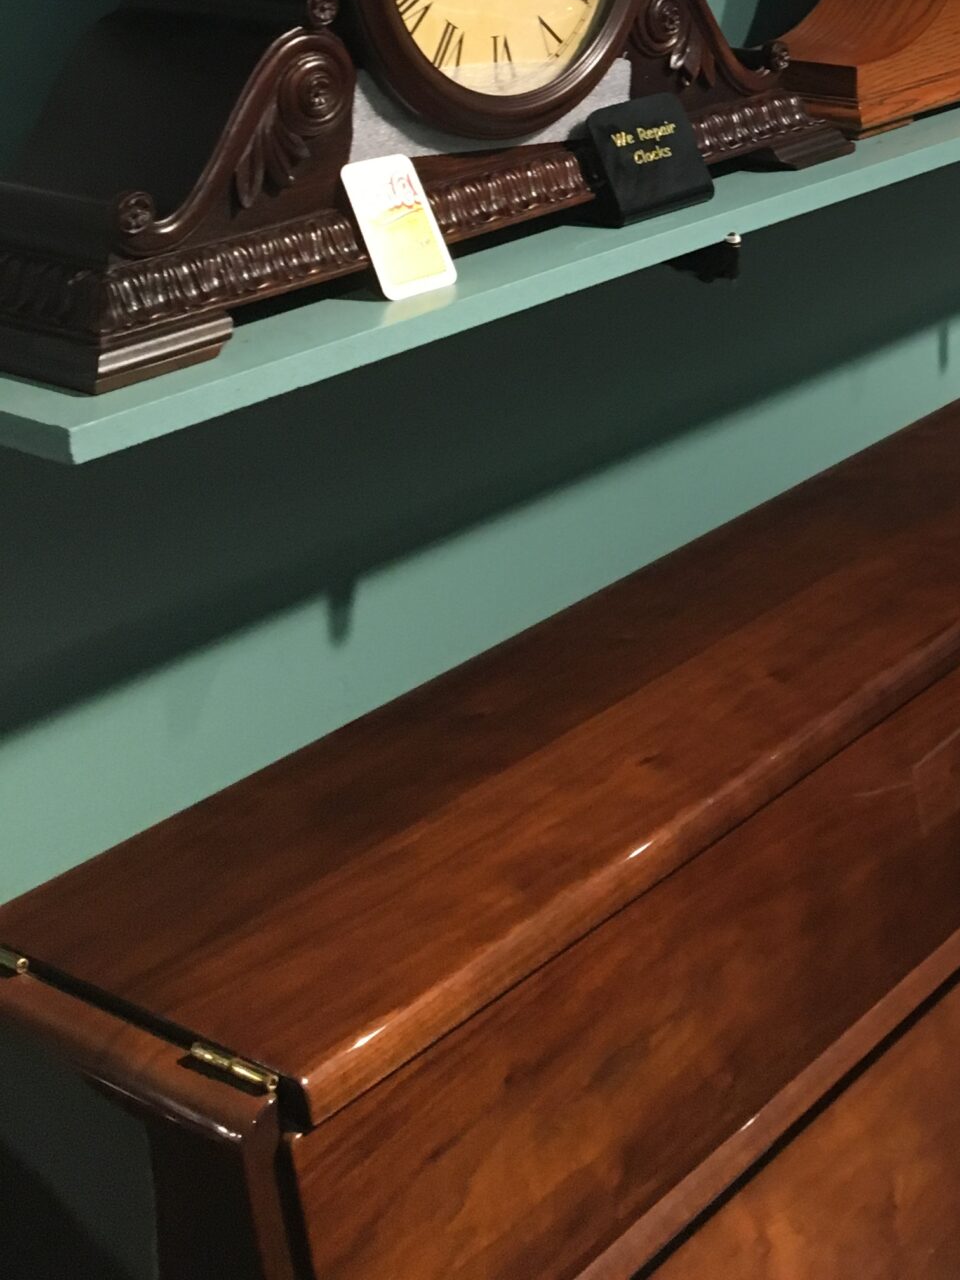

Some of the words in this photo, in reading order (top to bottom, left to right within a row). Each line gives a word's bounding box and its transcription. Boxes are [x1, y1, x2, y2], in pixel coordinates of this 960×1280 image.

[537, 15, 566, 58] V
[610, 131, 636, 148] We
[636, 121, 677, 142] Repair
[633, 144, 673, 165] Clocks
